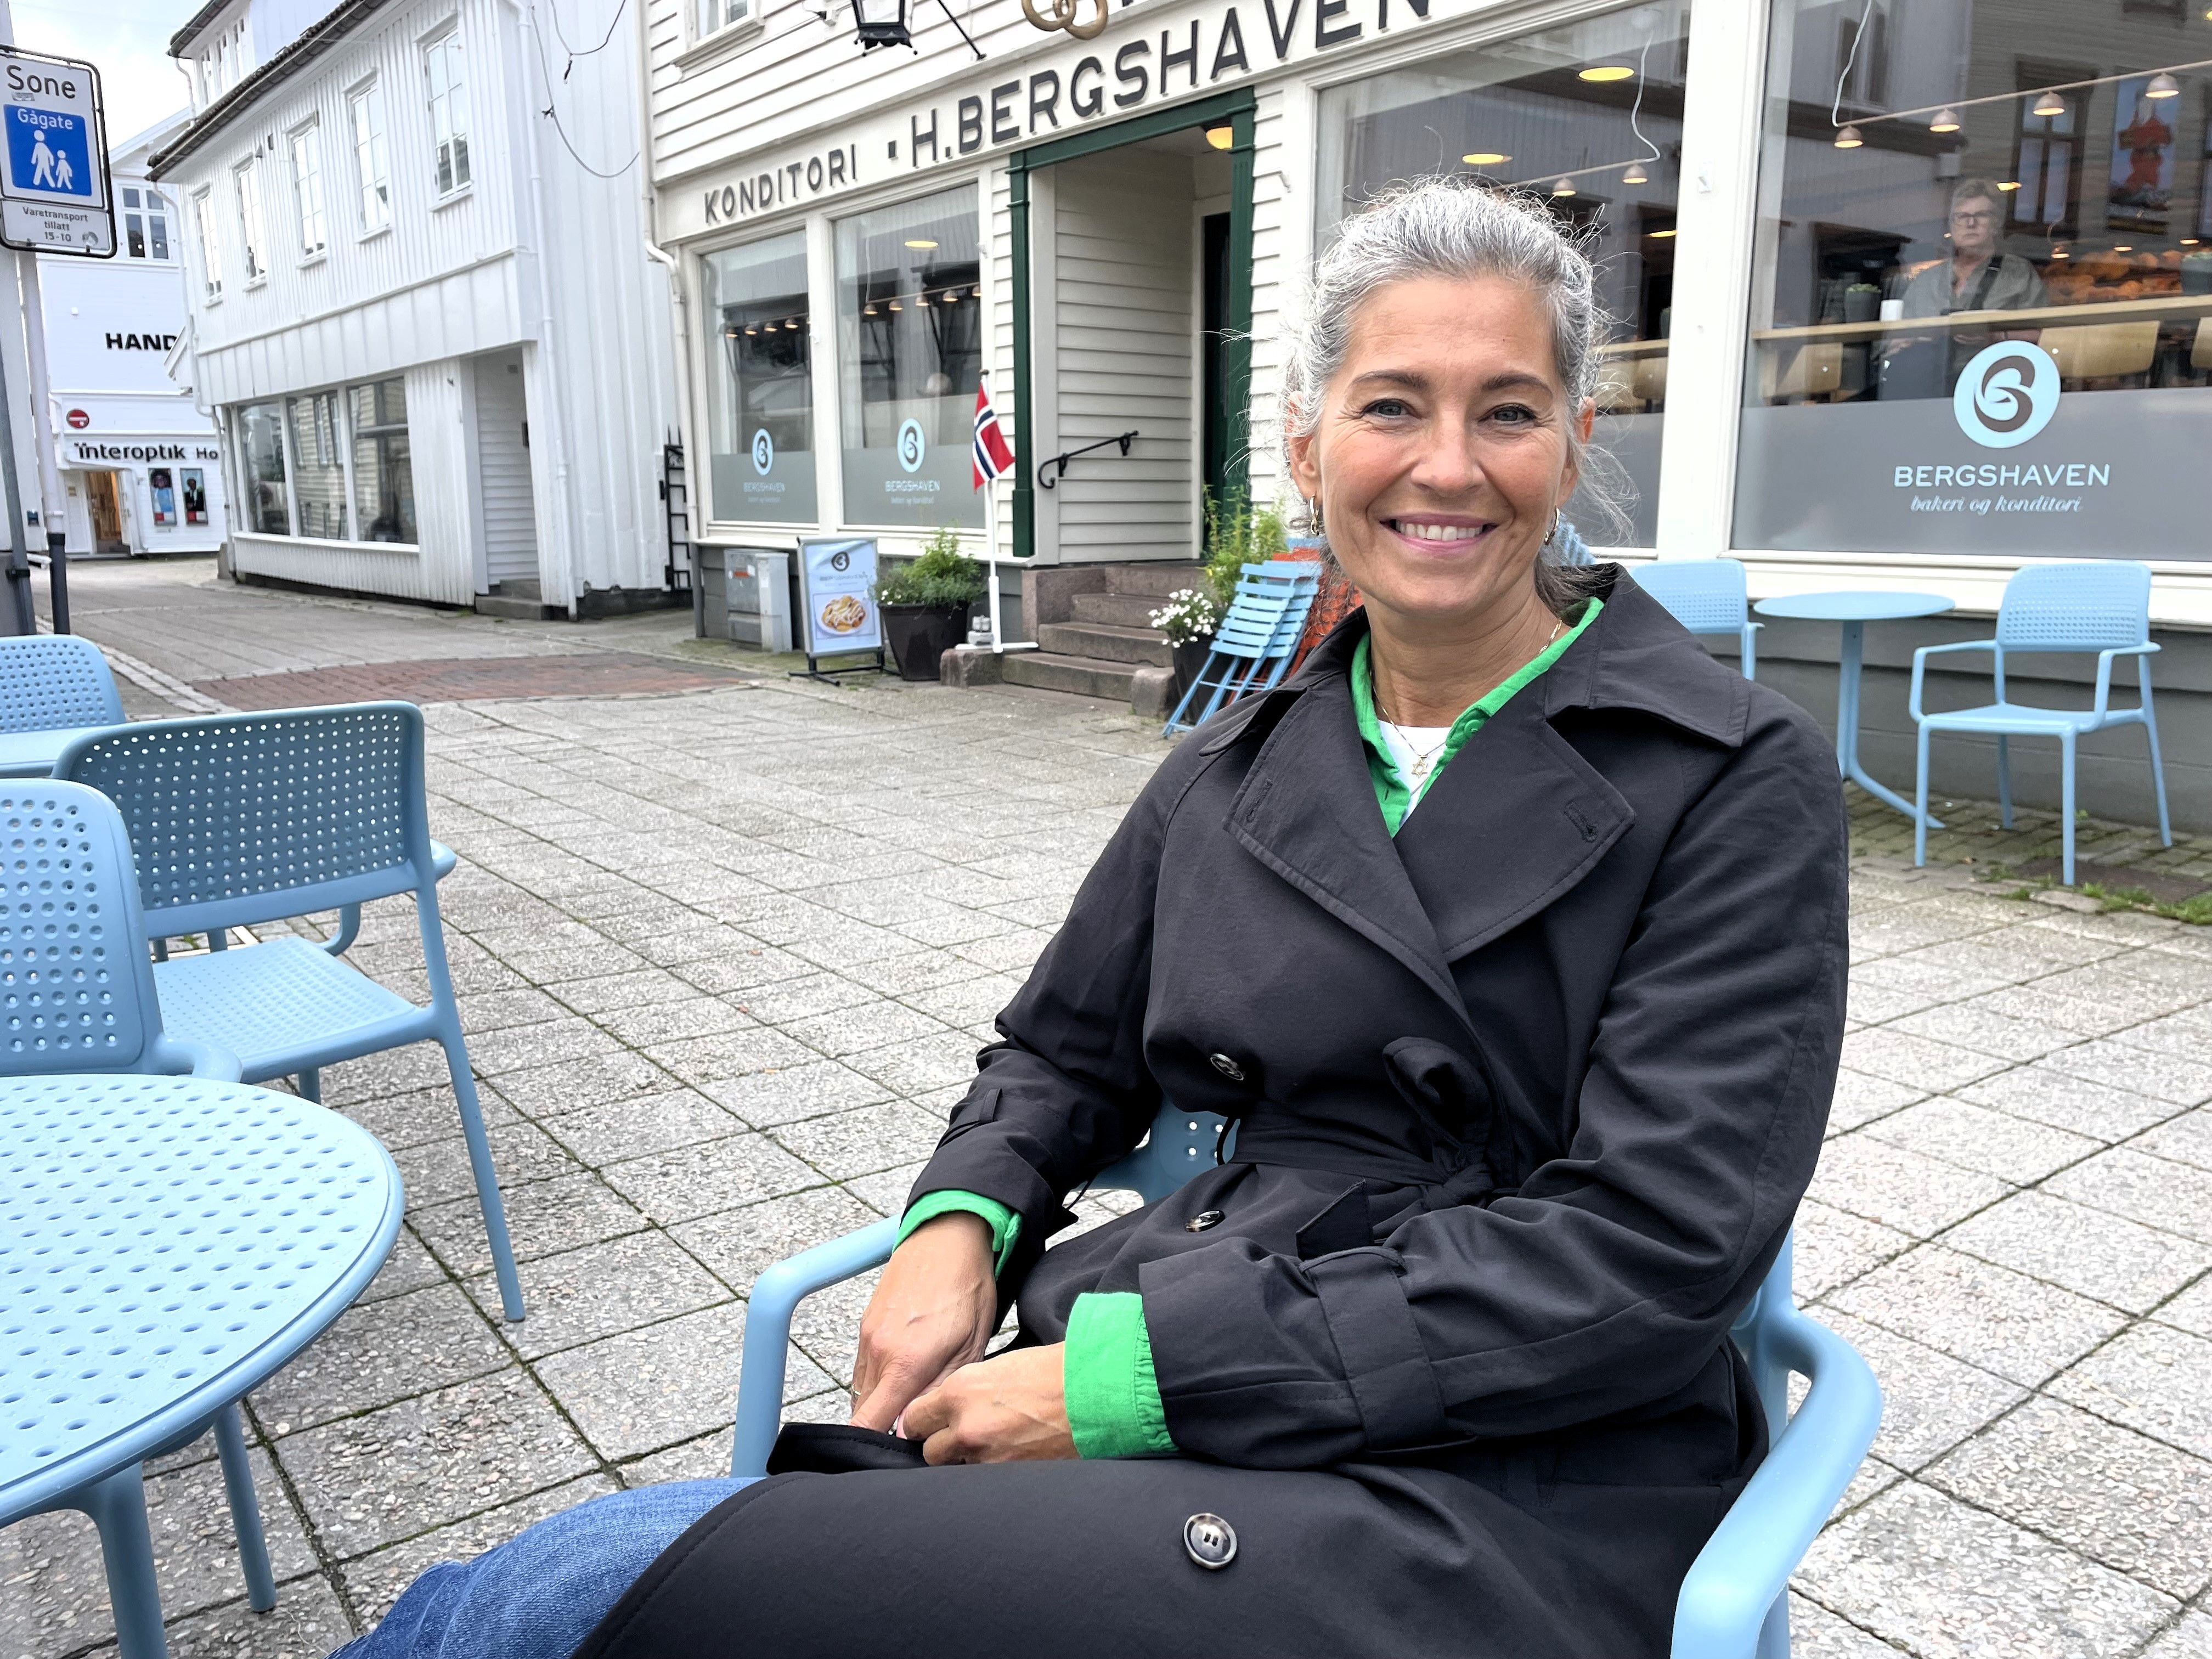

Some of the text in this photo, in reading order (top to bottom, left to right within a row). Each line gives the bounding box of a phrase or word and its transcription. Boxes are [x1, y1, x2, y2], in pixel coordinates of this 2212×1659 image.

[7, 65, 76, 99] Sone
[17, 108, 73, 129] Gågate
[704, 144, 856, 224] KONDITORI
[22, 206, 88, 222] Varetransport
[44, 221, 70, 230] tillatt
[1894, 464, 2111, 488] BERGSHAVEN
[1910, 495, 2083, 516] bakeri og konditori
